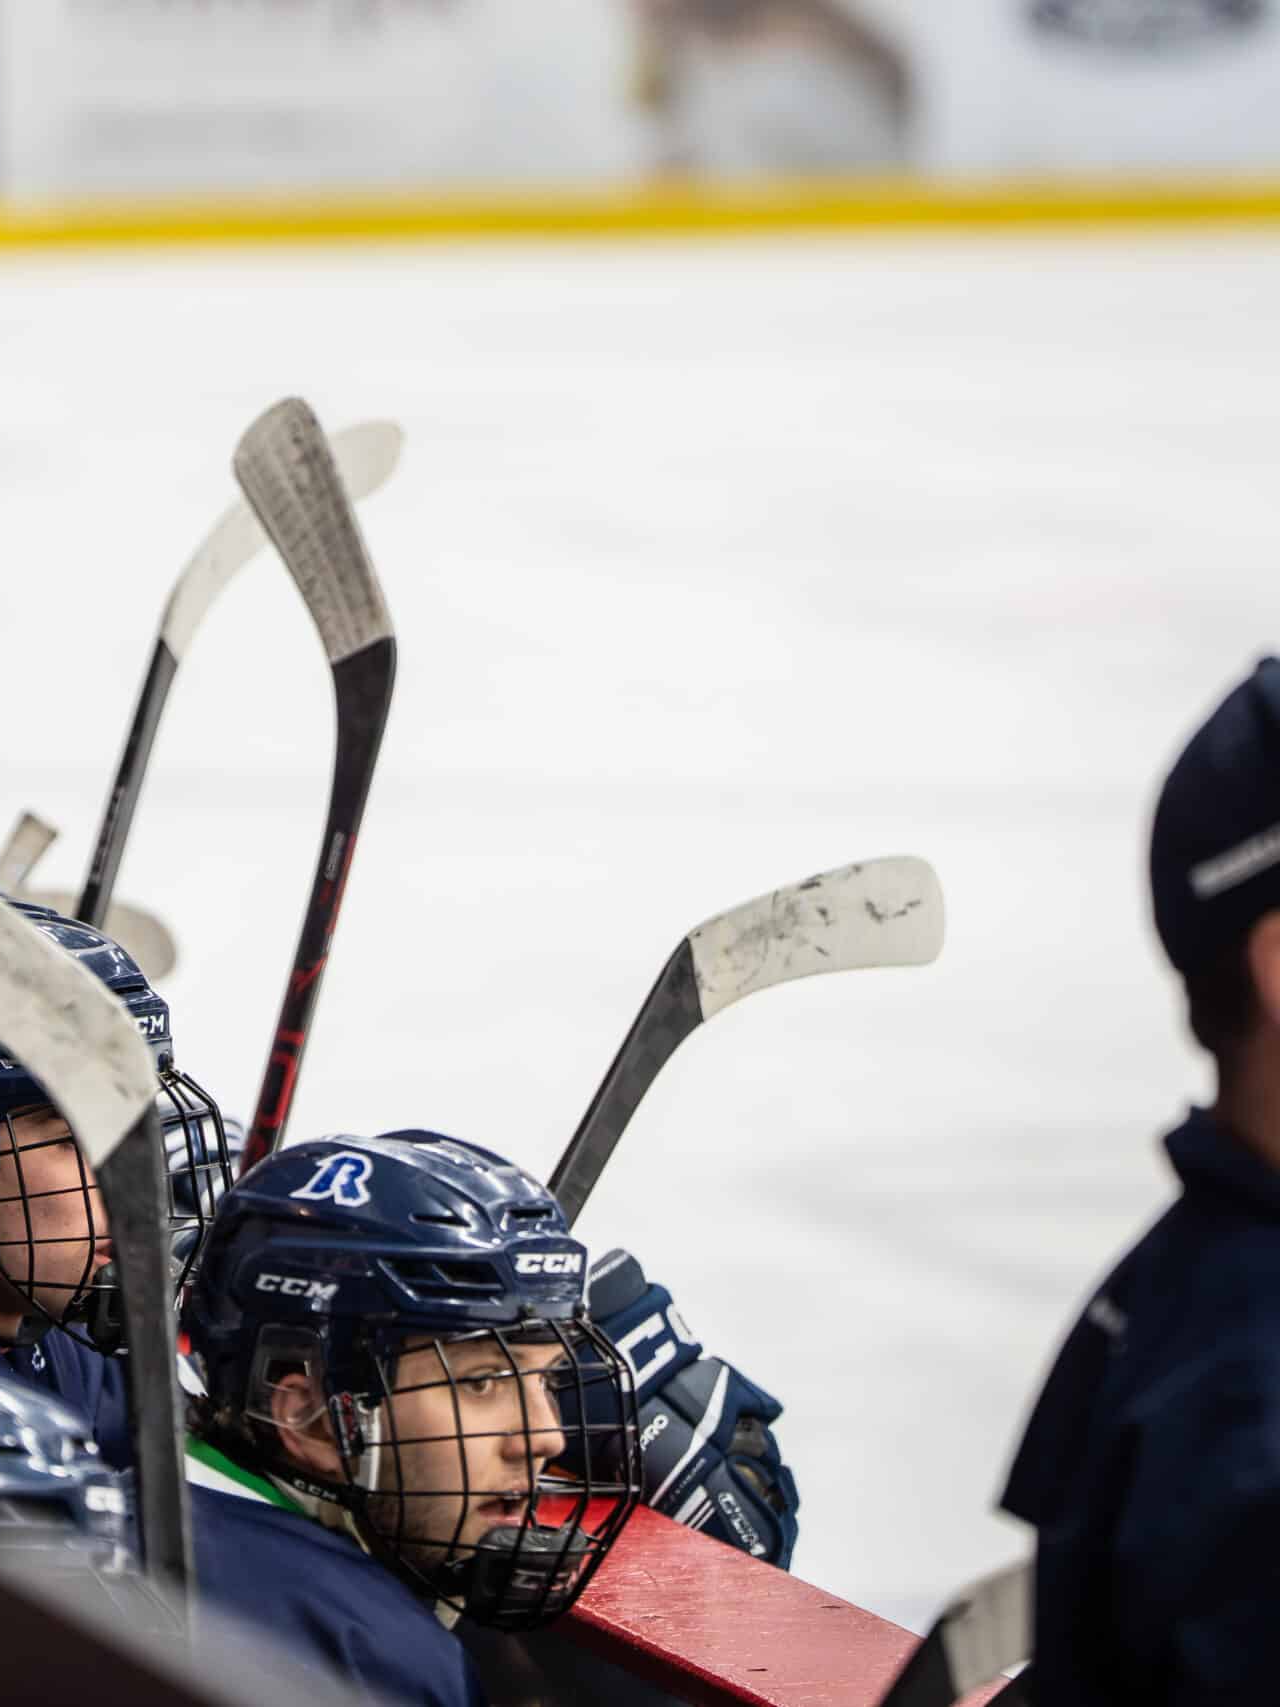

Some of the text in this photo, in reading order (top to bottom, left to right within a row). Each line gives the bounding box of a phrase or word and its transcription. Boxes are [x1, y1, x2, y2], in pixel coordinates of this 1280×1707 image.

[135, 1014, 165, 1034] CM
[288, 1151, 373, 1207] R
[514, 1253, 583, 1275] CCM
[255, 1273, 340, 1301] CCM
[640, 1414, 669, 1451] PRO
[718, 1492, 767, 1556] CCM
